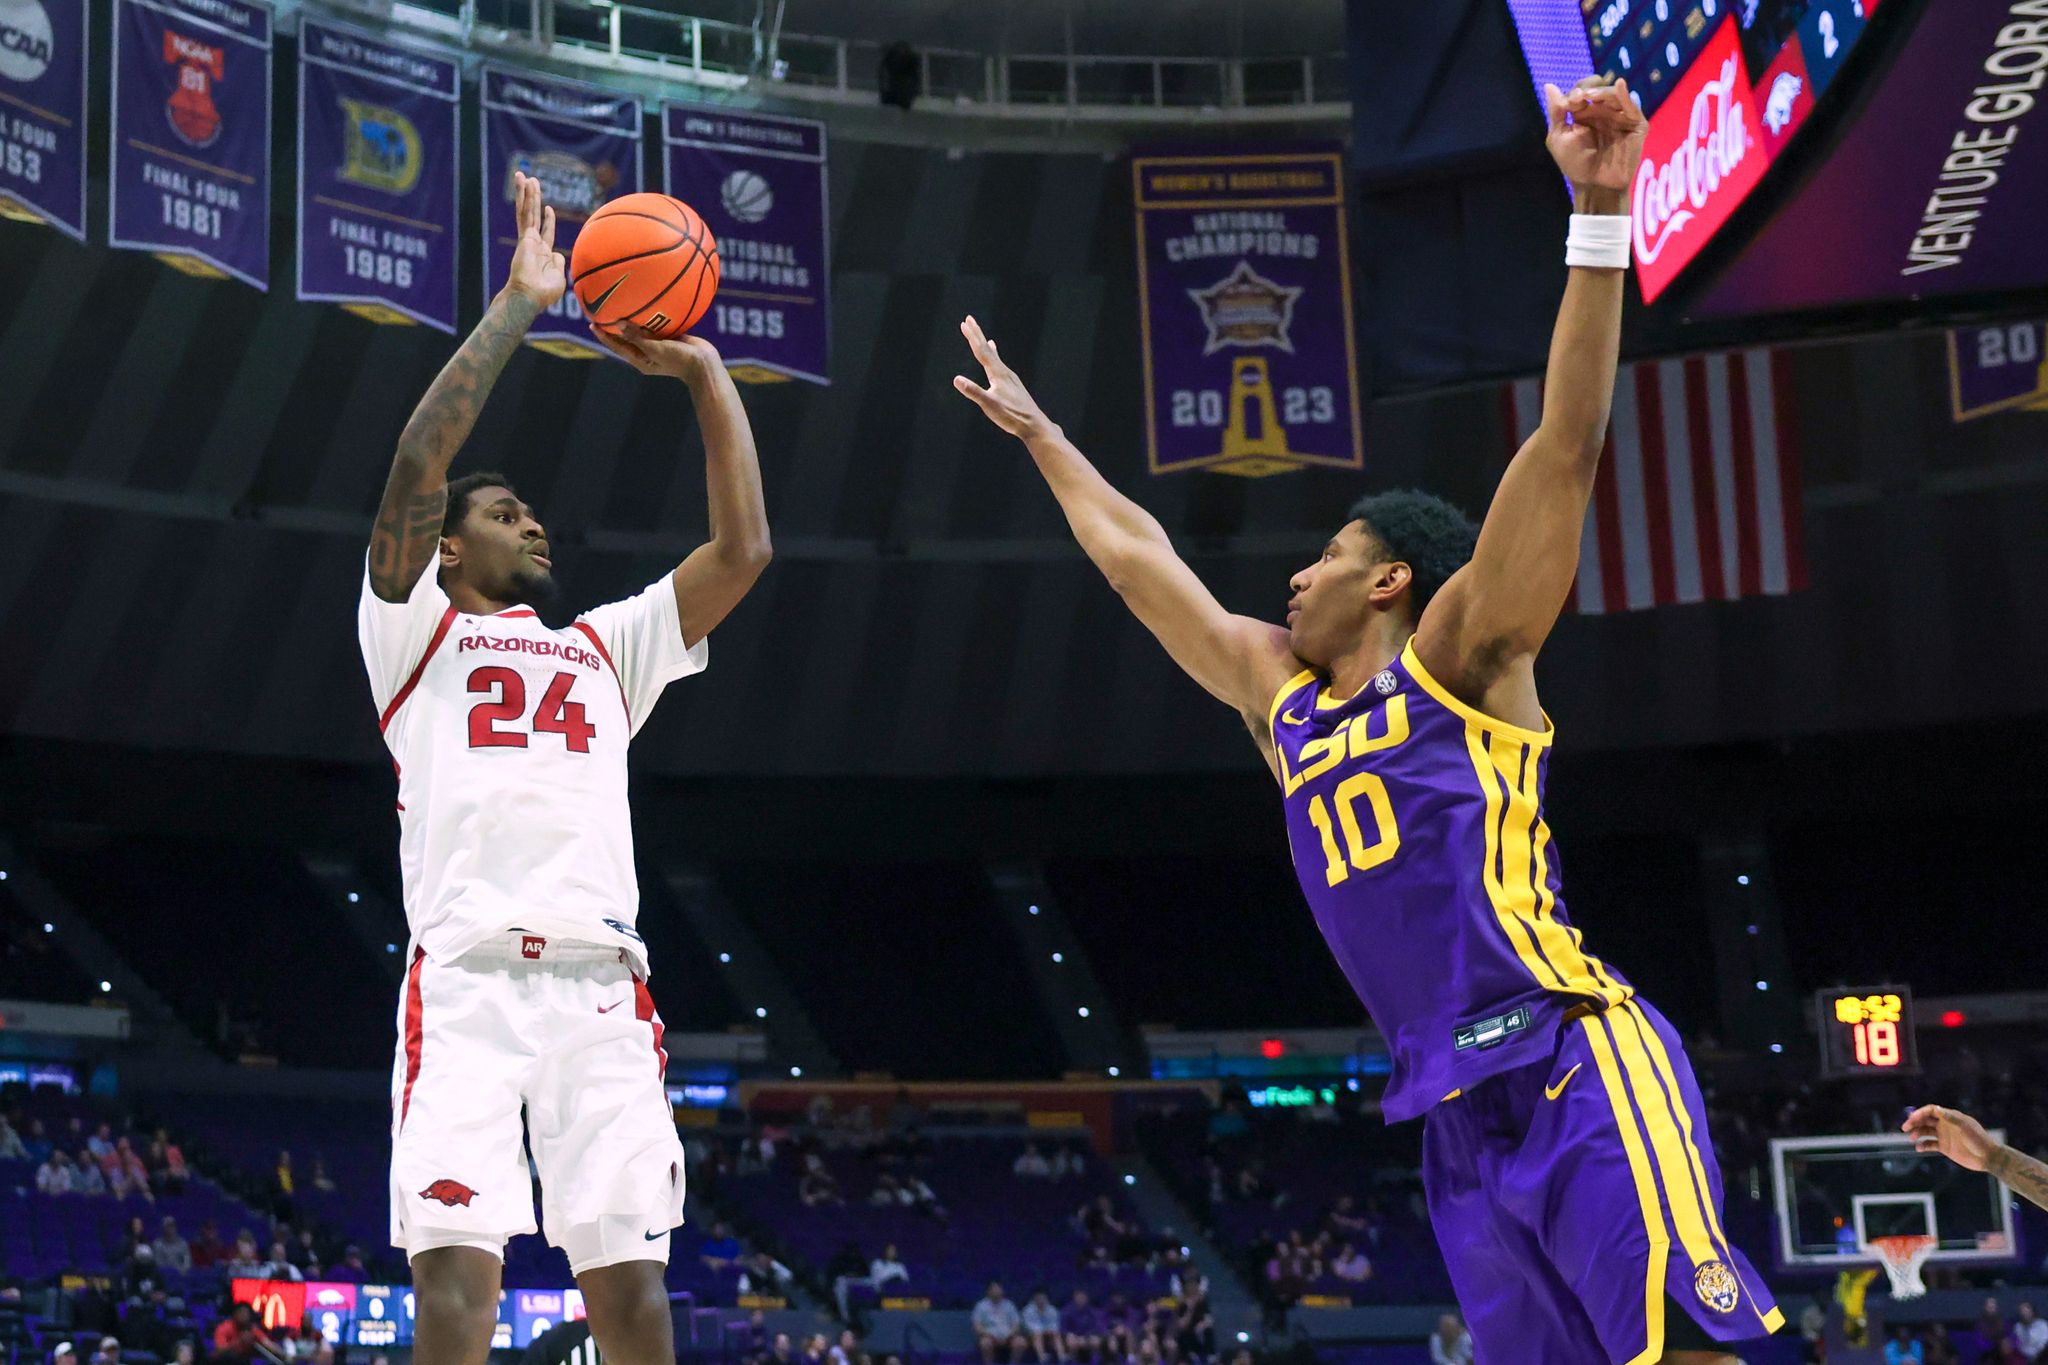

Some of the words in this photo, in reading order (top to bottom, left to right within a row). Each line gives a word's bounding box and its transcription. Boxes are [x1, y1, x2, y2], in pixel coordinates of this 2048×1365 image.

[1818, 10, 1839, 59] 2
[0, 138, 41, 183] 53
[143, 162, 190, 196] FINAL
[195, 180, 240, 211] FOUR
[1901, 124, 2019, 276] VENTURE
[163, 193, 221, 240] 1981
[1193, 211, 1286, 233] NATIONAL
[330, 217, 377, 248] FINAL
[382, 231, 427, 259] FOUR
[716, 237, 798, 266] ATIONAL
[1165, 231, 1319, 262] CHAMPIONS
[345, 245, 412, 288] 1986
[718, 258, 809, 288] AMPIONS
[716, 303, 784, 339] 1935
[1978, 323, 2037, 367] 20
[1172, 389, 1223, 427] 20
[1284, 386, 1335, 424] 23
[458, 635, 601, 672] RAZORBACKS
[466, 665, 597, 754] 24
[1277, 693, 1410, 799] LSU
[1308, 771, 1400, 888] 10
[524, 941, 543, 953] AR
[1853, 1020, 1900, 1066] 18
[369, 1297, 384, 1319] 0
[521, 1294, 561, 1314] LSU
